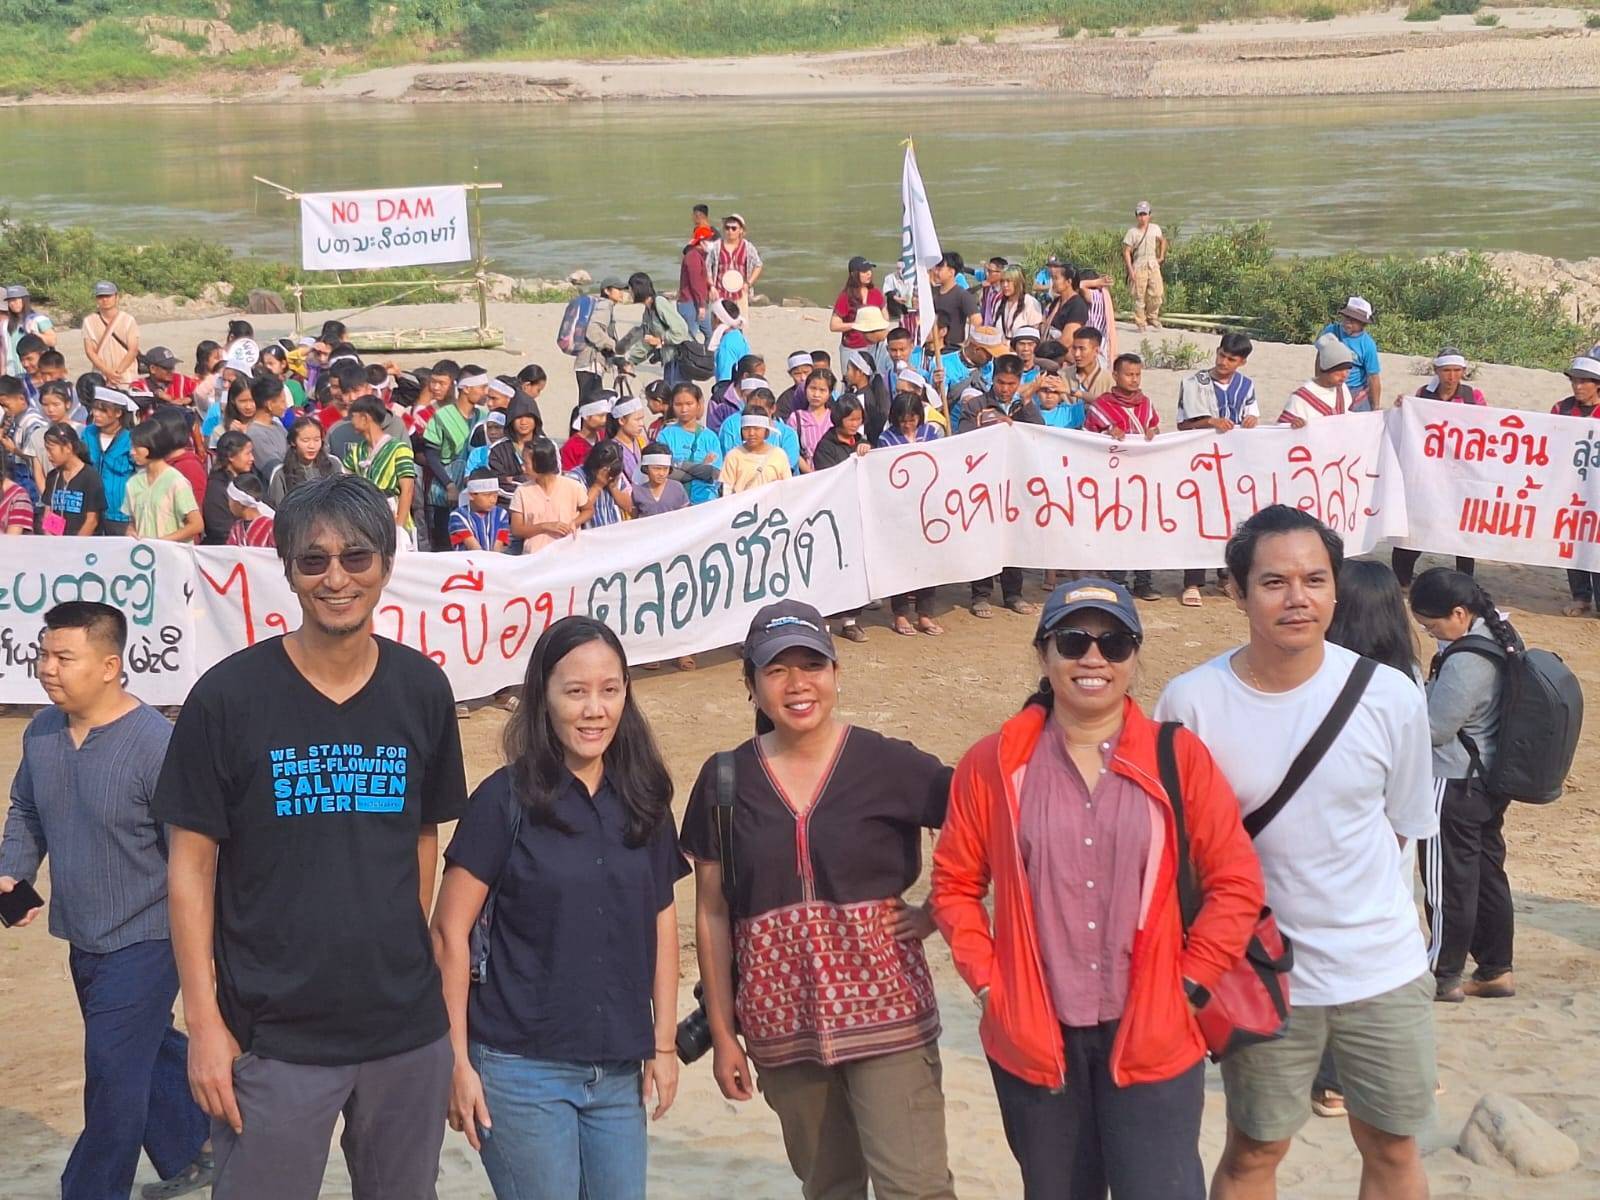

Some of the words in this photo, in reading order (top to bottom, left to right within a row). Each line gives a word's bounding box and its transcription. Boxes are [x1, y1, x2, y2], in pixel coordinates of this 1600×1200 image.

[331, 201, 359, 224] NO
[377, 197, 434, 222] DAM
[1423, 415, 1549, 466] สาละวิน
[1458, 475, 1543, 539] แม่น้ำ
[1553, 493, 1600, 559] ผู้ก
[270, 748, 297, 761] WE
[308, 744, 363, 757] STAND
[376, 746, 407, 759] FOR
[272, 757, 407, 778] FREE-FLOWING
[274, 773, 407, 799] SALWEEN
[276, 795, 352, 816] RIVER
